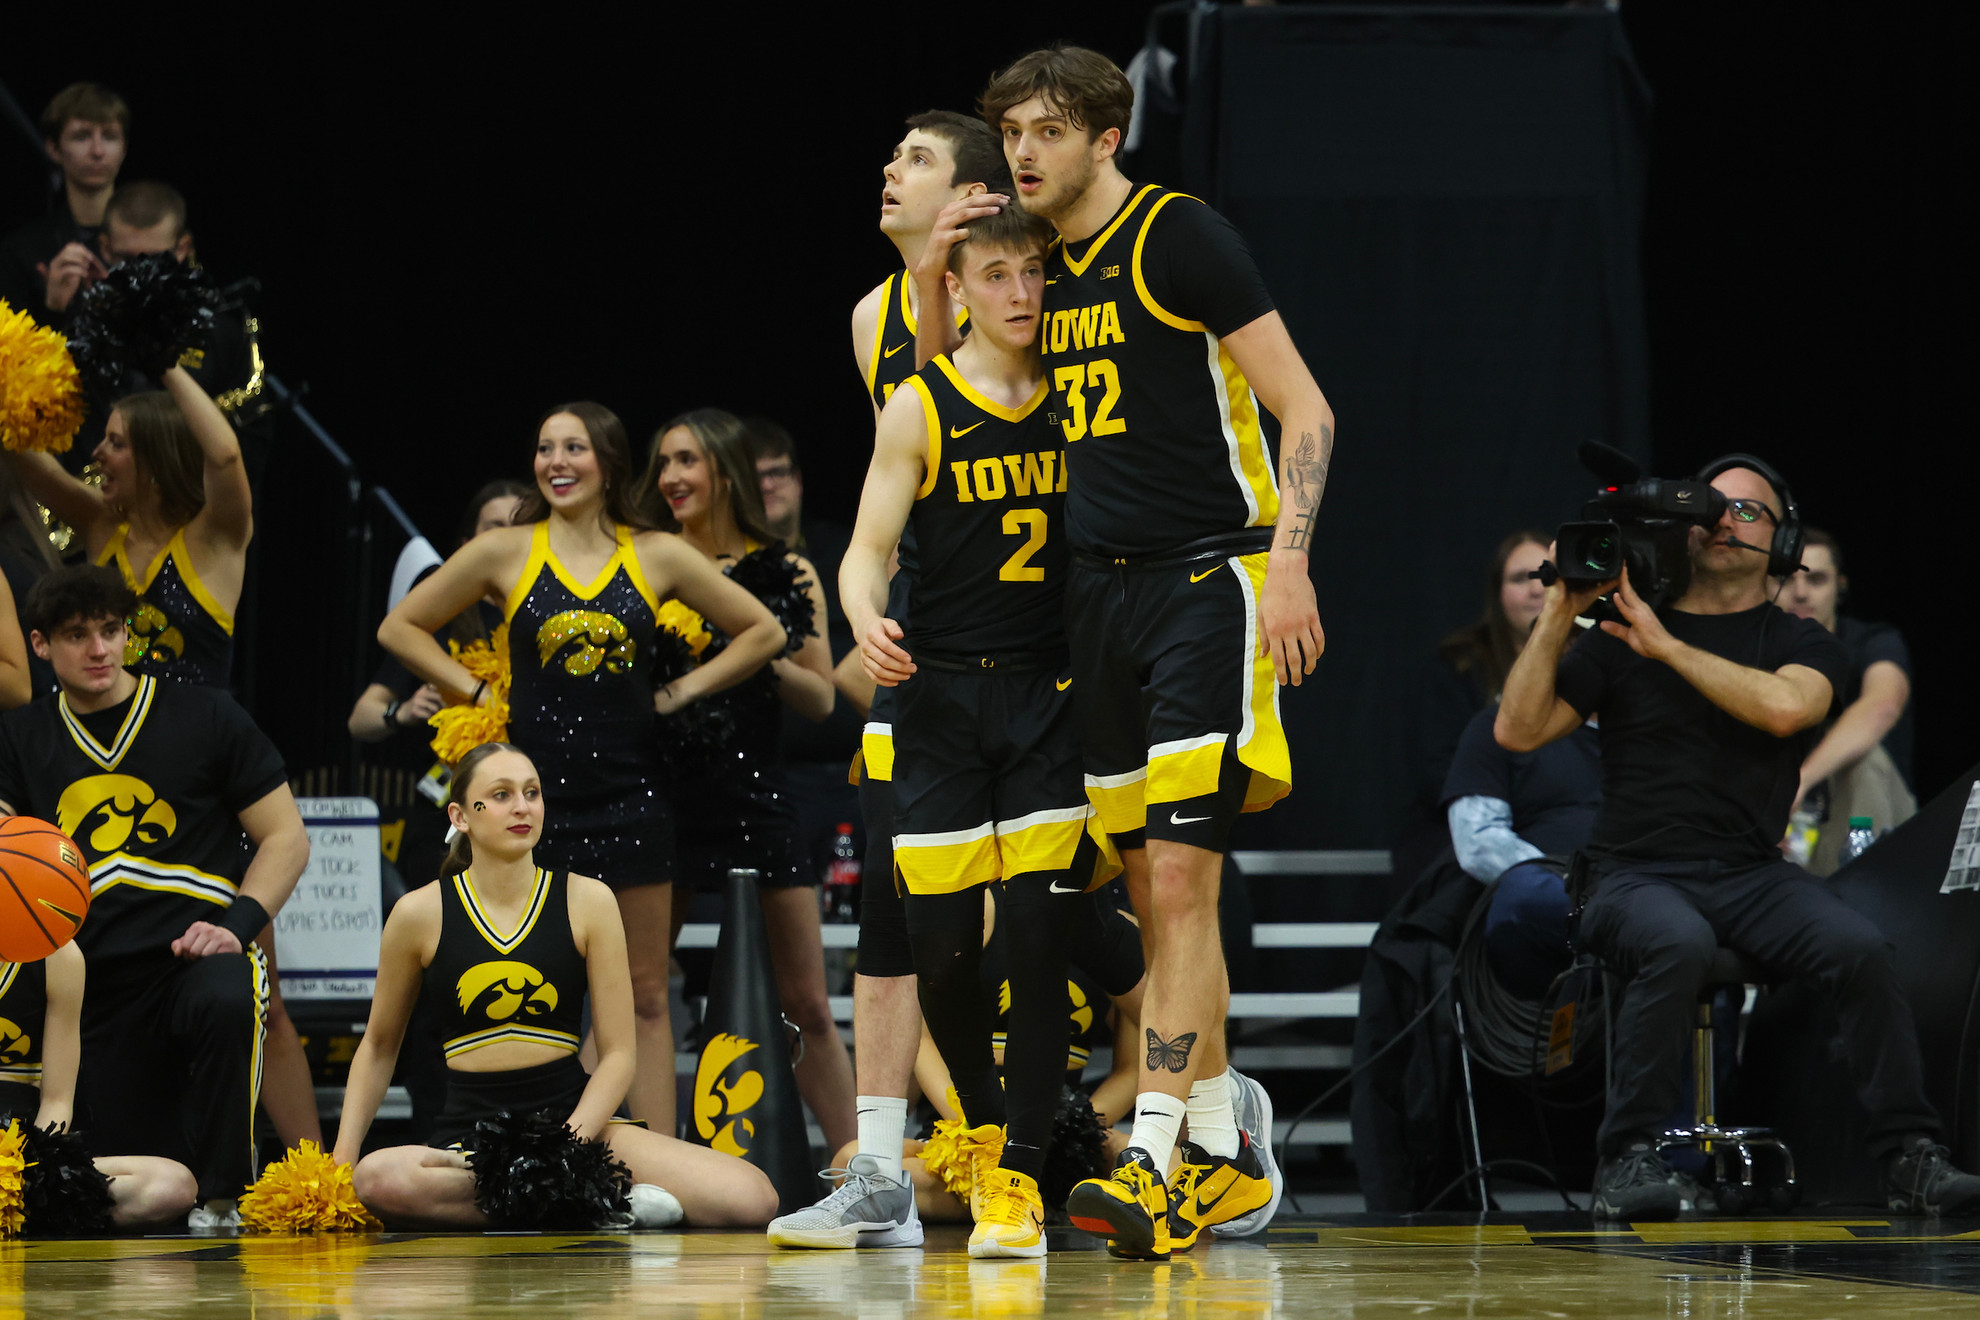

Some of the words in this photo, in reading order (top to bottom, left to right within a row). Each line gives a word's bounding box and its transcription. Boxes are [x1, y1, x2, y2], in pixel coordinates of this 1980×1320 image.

[1054, 358, 1127, 443] 32
[950, 450, 1068, 503] IOW
[999, 508, 1048, 582] 2
[319, 831, 354, 849] CAM
